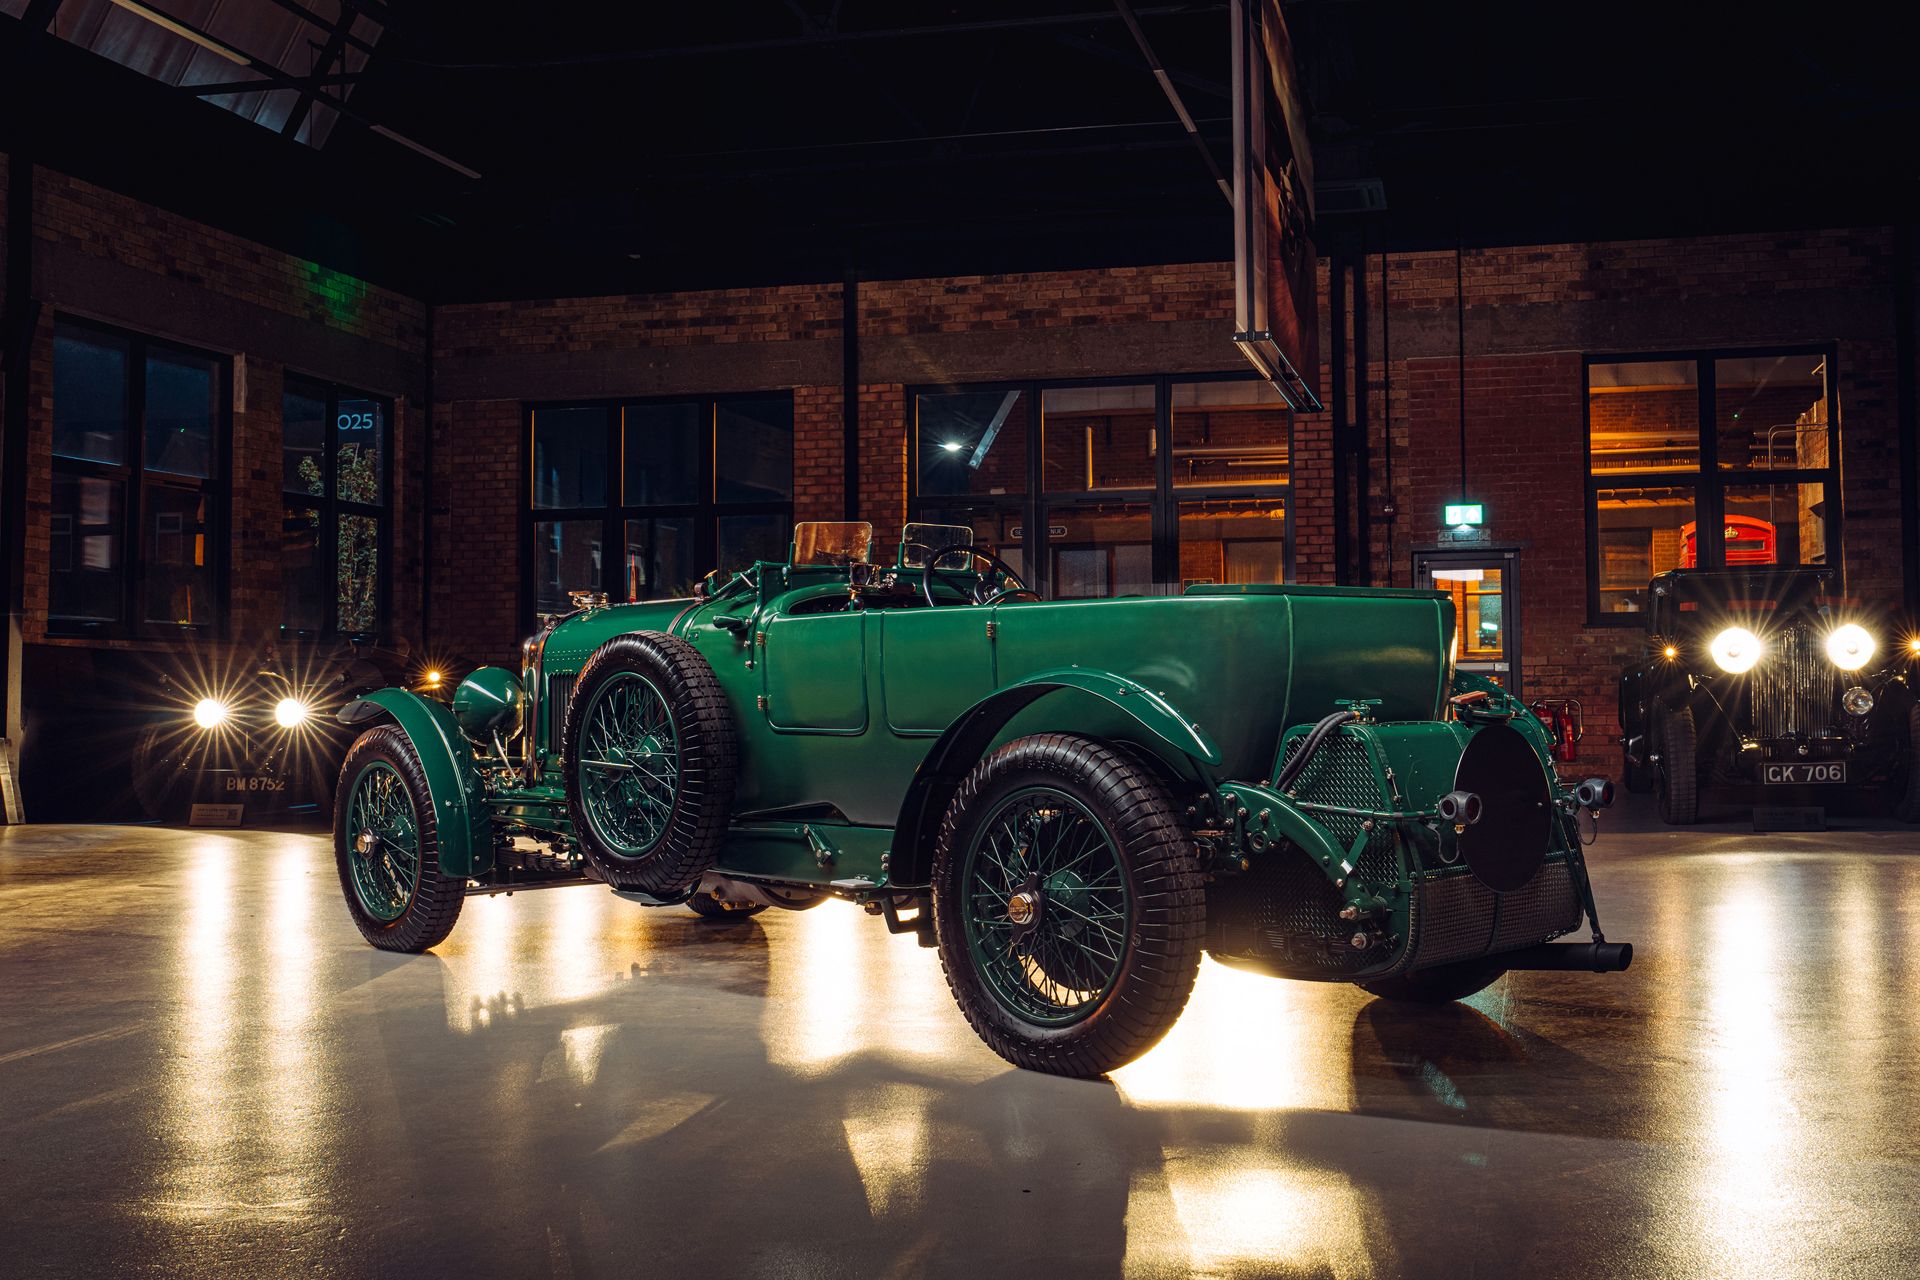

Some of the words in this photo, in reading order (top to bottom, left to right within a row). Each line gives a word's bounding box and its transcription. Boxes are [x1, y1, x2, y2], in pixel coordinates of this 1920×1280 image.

[1768, 766, 1795, 782] GK
[1801, 764, 1842, 782] 706
[226, 776, 246, 791] BM
[249, 776, 285, 791] 8752
